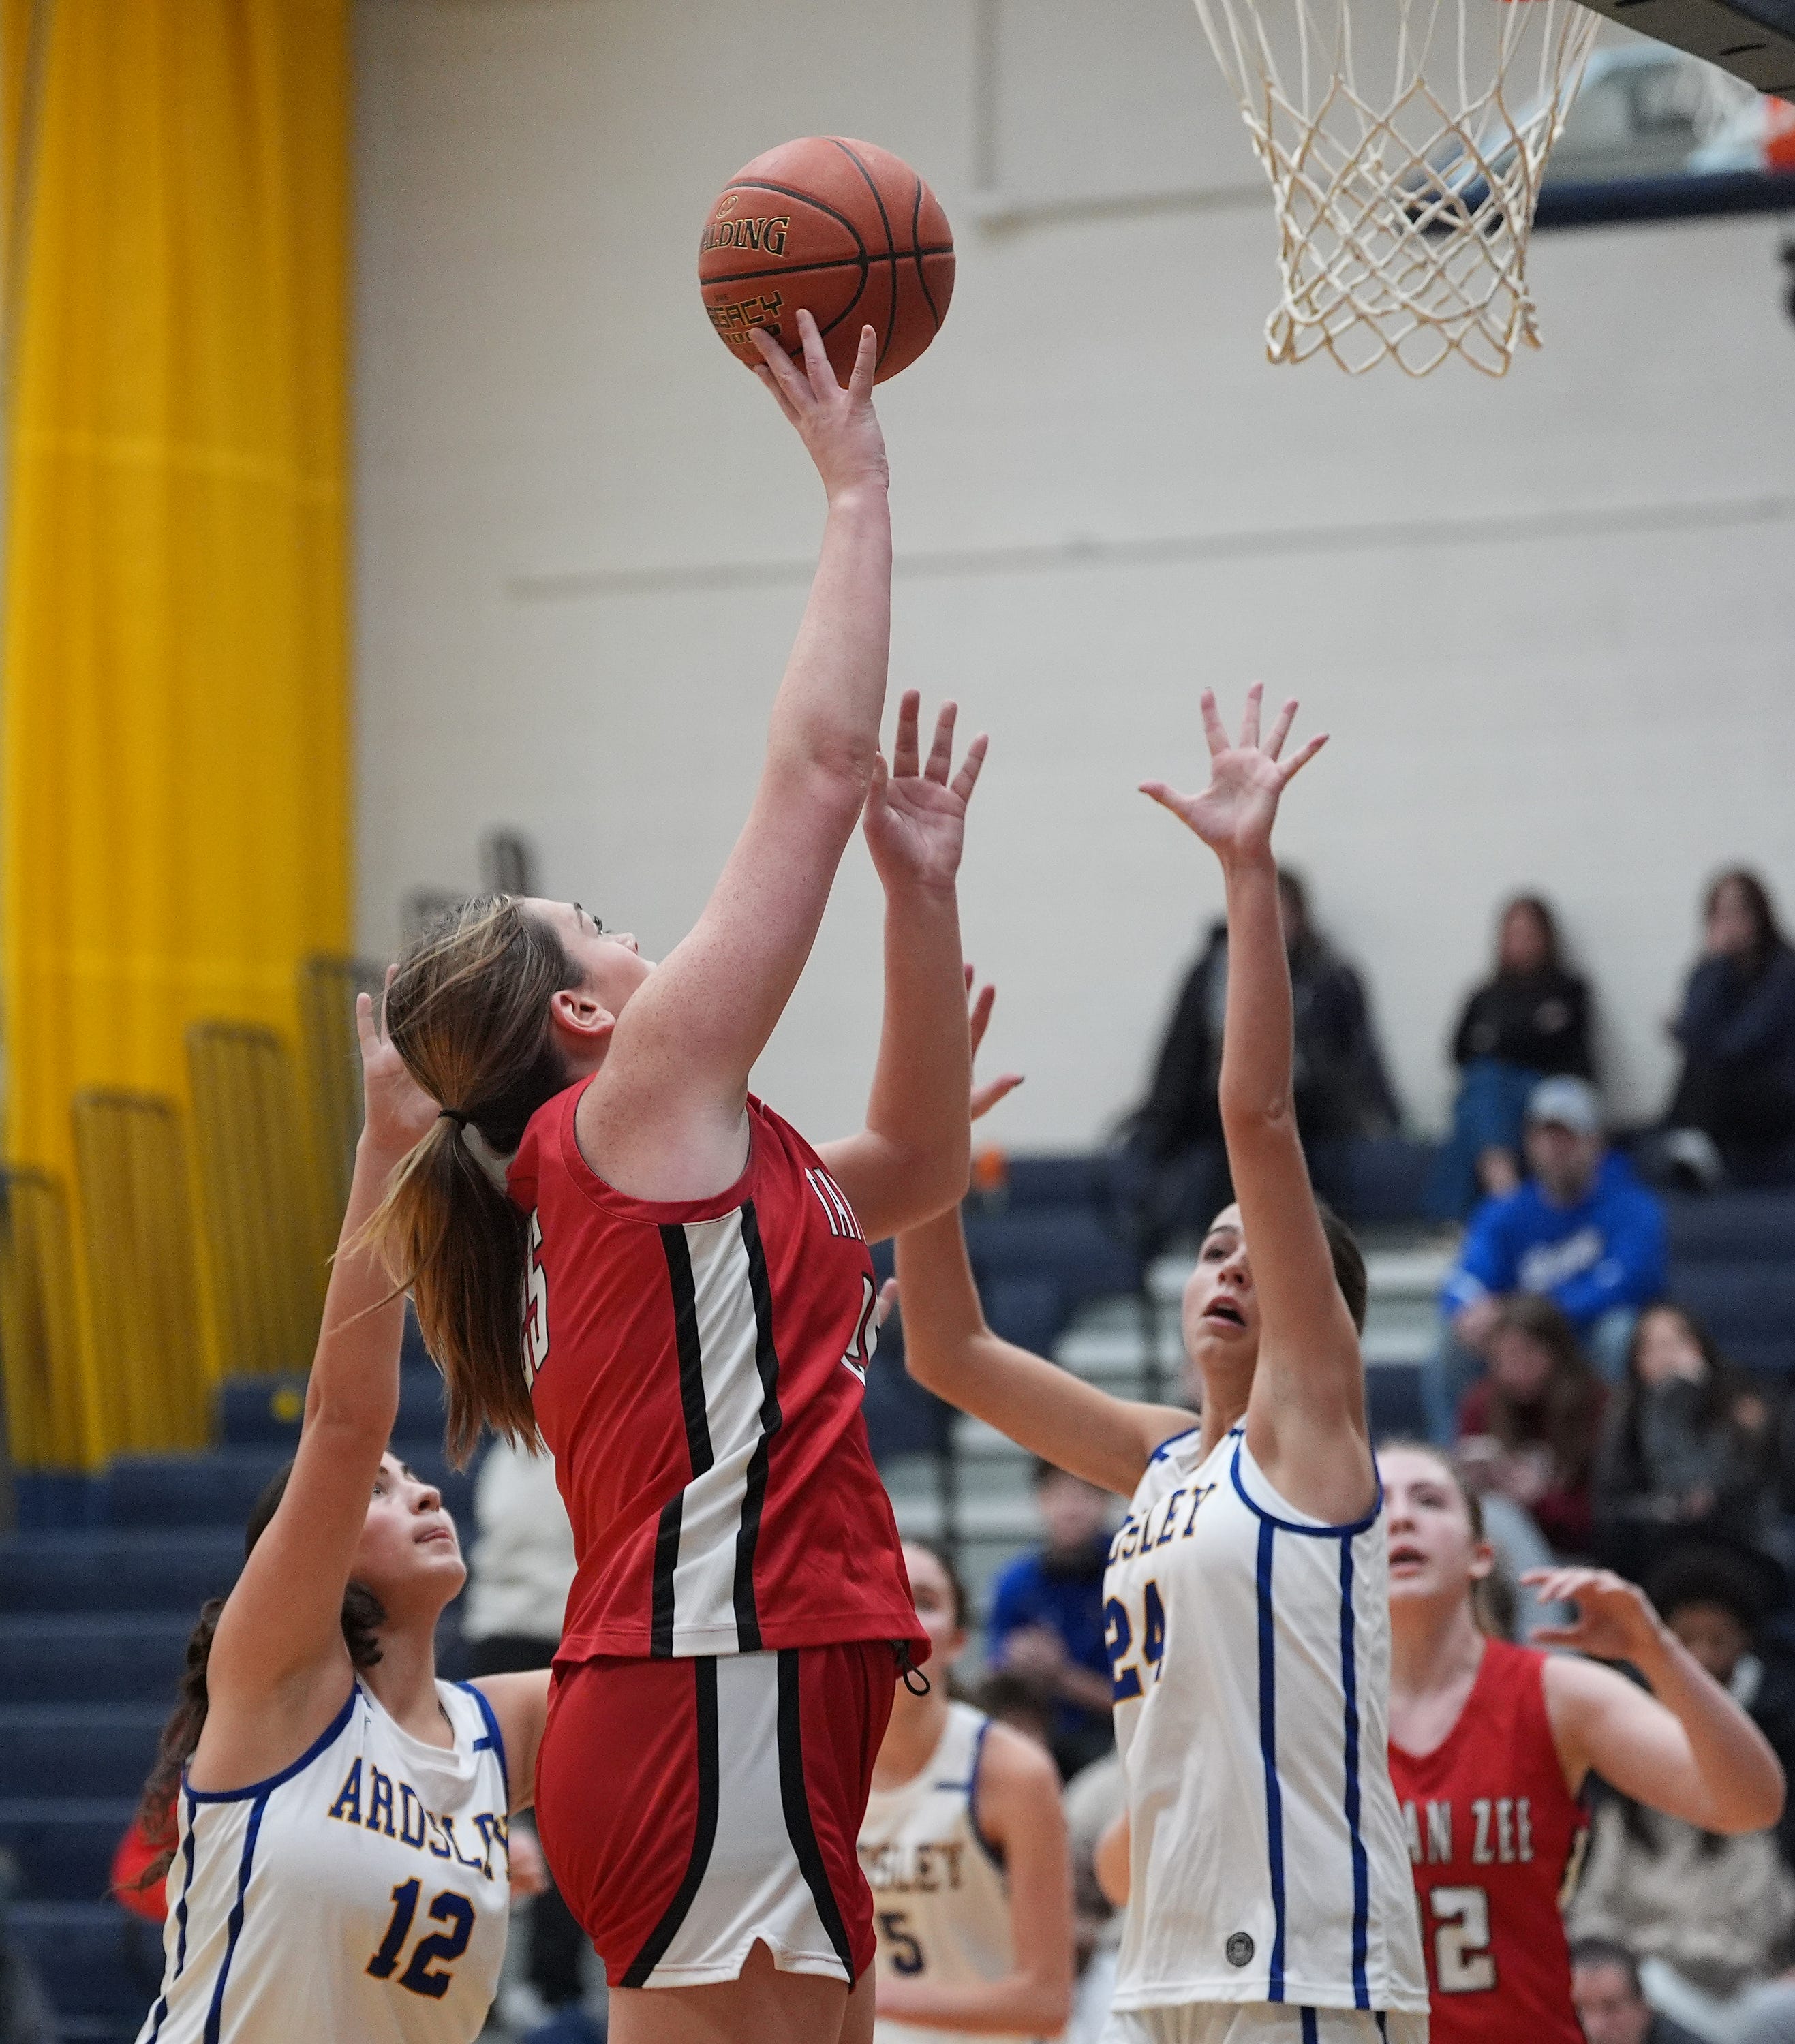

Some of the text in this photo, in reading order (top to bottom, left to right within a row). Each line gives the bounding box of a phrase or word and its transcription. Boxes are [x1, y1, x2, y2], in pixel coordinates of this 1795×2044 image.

[1470, 1795, 1535, 1865] ZEE
[365, 1875, 476, 2000] 12
[1419, 1885, 1497, 1993] 2
